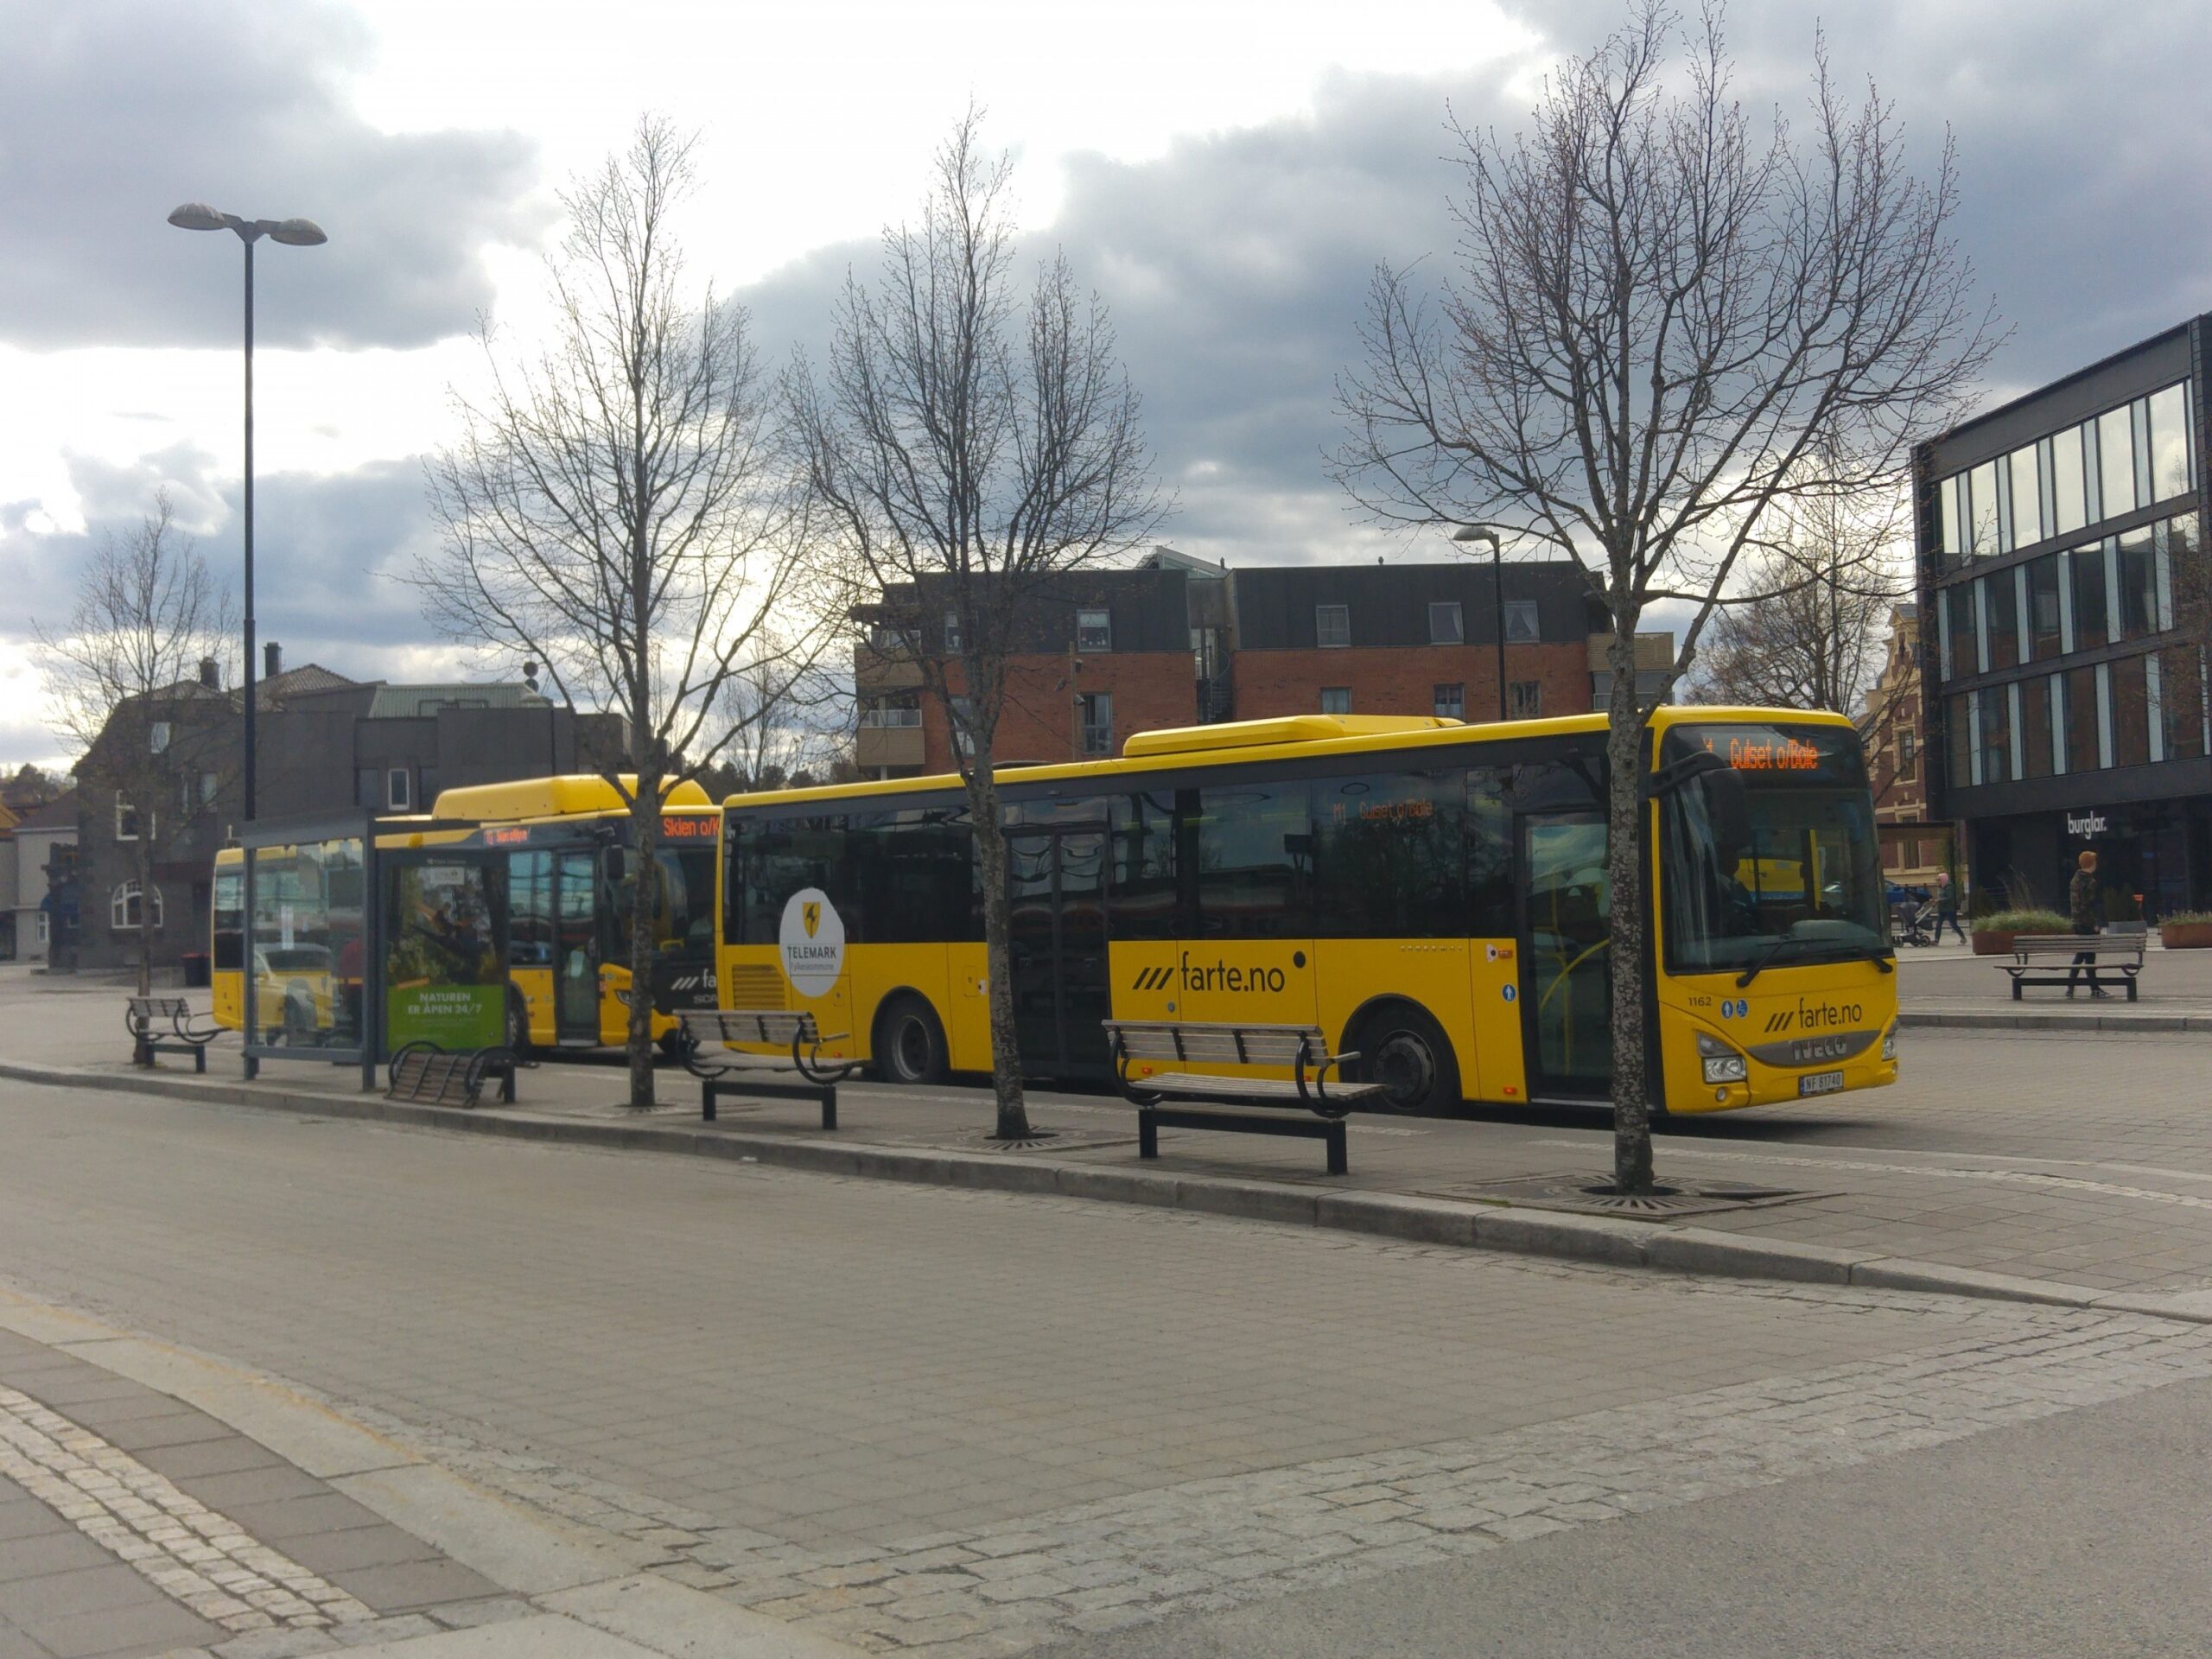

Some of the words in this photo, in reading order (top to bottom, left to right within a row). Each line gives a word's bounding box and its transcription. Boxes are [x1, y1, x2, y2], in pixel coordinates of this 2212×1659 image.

[663, 817, 696, 837] Skien
[2067, 810, 2107, 840] burglar.
[787, 946, 837, 959] TELEMARK
[1181, 951, 1286, 993] farte.no
[419, 992, 471, 1002] NATUREN
[1688, 996, 1712, 1007] 1162
[408, 1004, 420, 1014] ER
[423, 1001, 453, 1014] ÅPEN
[455, 1003, 482, 1015] 24/7
[1799, 997, 1862, 1029] farte.no
[1793, 1036, 1847, 1061] IVECO
[1818, 1072, 1841, 1089] 81740
